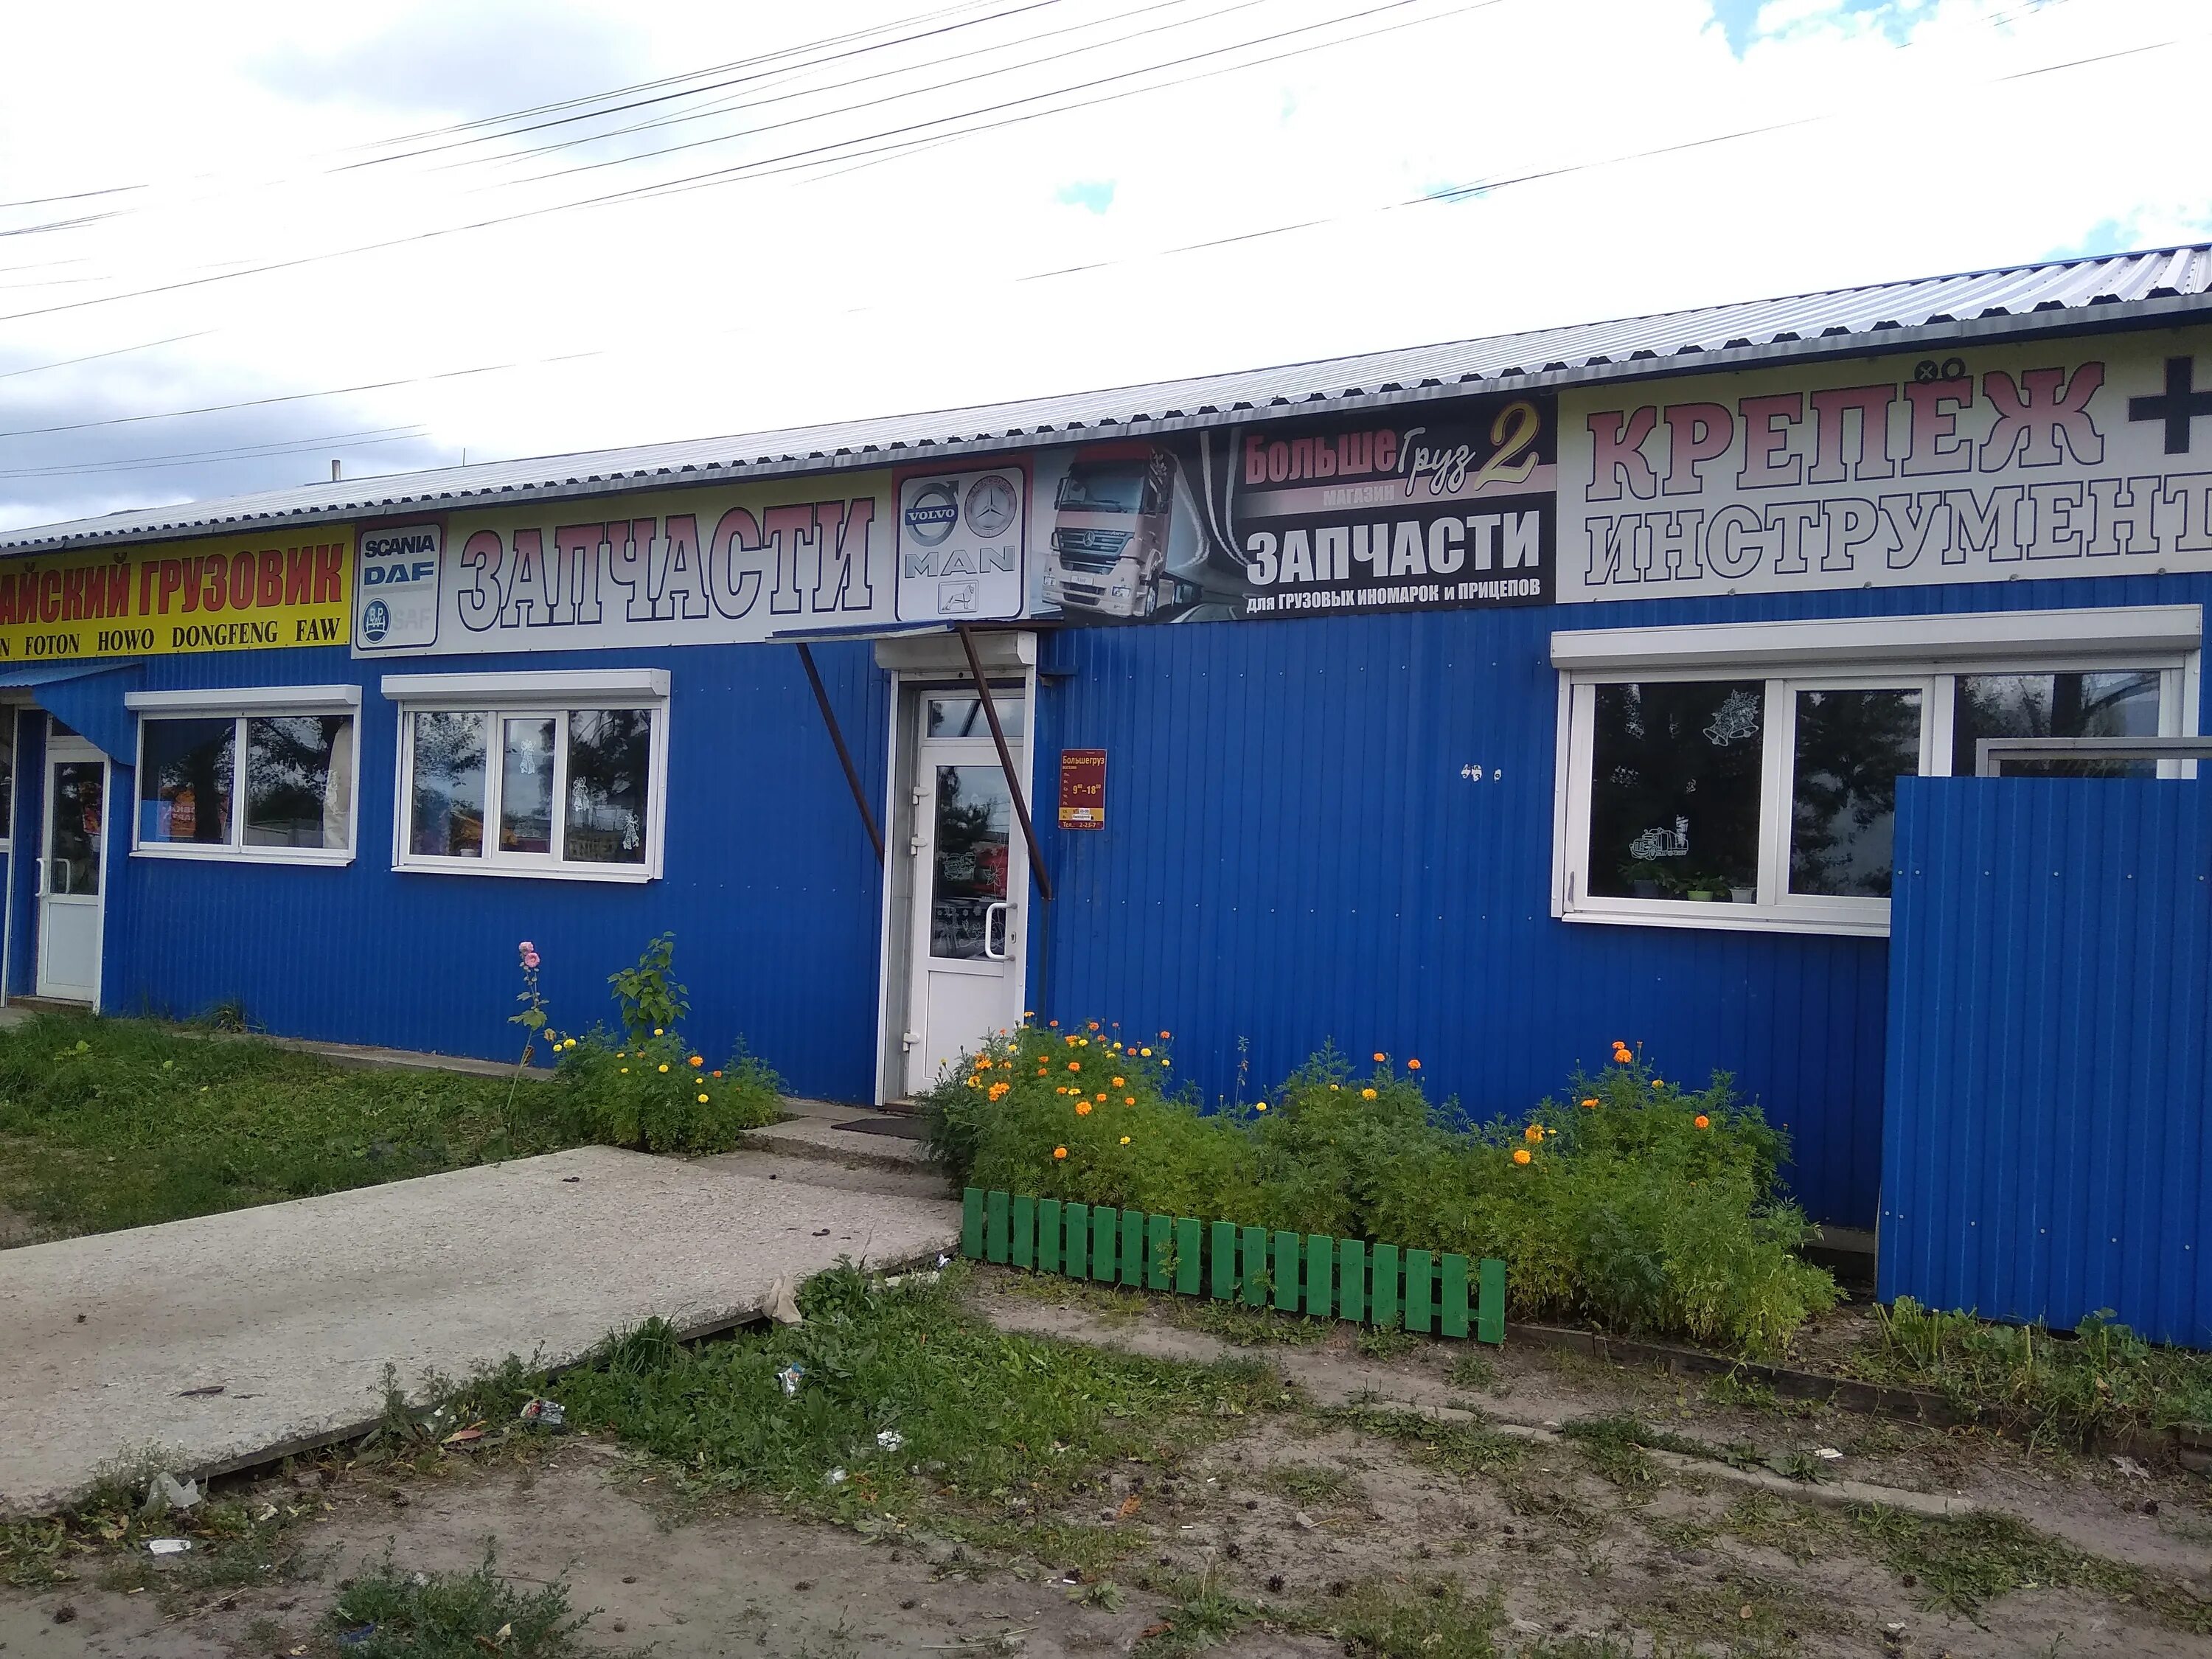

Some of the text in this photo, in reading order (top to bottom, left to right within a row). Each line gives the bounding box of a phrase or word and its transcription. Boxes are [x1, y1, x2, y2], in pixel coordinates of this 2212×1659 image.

[1475, 402, 1541, 491] 2
[1586, 357, 2105, 503] КРЕПЁЖ
[1323, 485, 1394, 507] МАГАЗИН
[908, 508, 955, 521] VOLVO
[1585, 472, 2212, 586] ИНСТРУМЕНТ
[364, 535, 435, 558] SCANIA
[458, 497, 875, 632] ЗАПЧАСТИ
[905, 545, 1015, 579] MAN
[1246, 510, 1540, 585] ЗАПЧАСТИ
[139, 542, 345, 616] ГРУЗОВИК
[364, 561, 435, 586] DAF
[1279, 590, 1354, 610] ГРУЗОВЫХ
[1357, 584, 1439, 605] ИНОМАРОК
[1458, 578, 1541, 601] ПРИЦЕПОВ
[25, 633, 80, 655] FOTON
[97, 628, 155, 652] HOWO
[172, 619, 279, 647] DONGFENG
[295, 617, 341, 642] FAW
[1062, 755, 1105, 766] Большегруз
